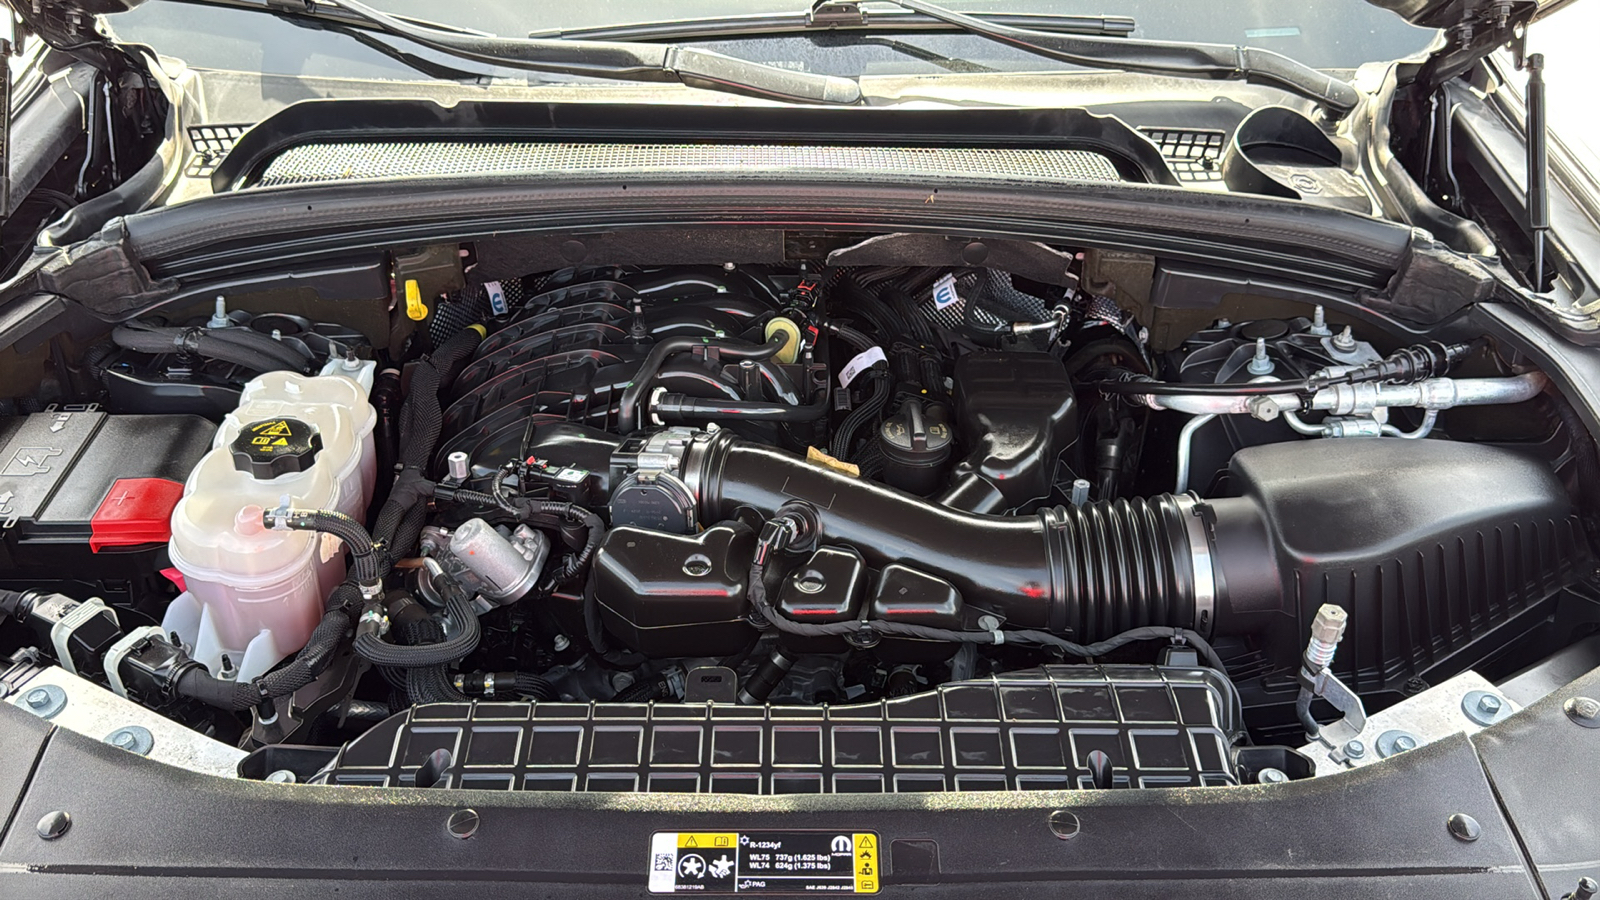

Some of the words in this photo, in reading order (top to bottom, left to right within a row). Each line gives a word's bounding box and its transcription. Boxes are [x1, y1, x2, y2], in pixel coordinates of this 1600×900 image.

[749, 841, 782, 850] R-1234yf
[775, 854, 793, 862] 737g
[794, 854, 816, 862] (1.625
[816, 854, 831, 862] lbs)
[775, 862, 793, 870] 624g
[794, 862, 816, 870] (1.375
[816, 862, 831, 870] lbs)
